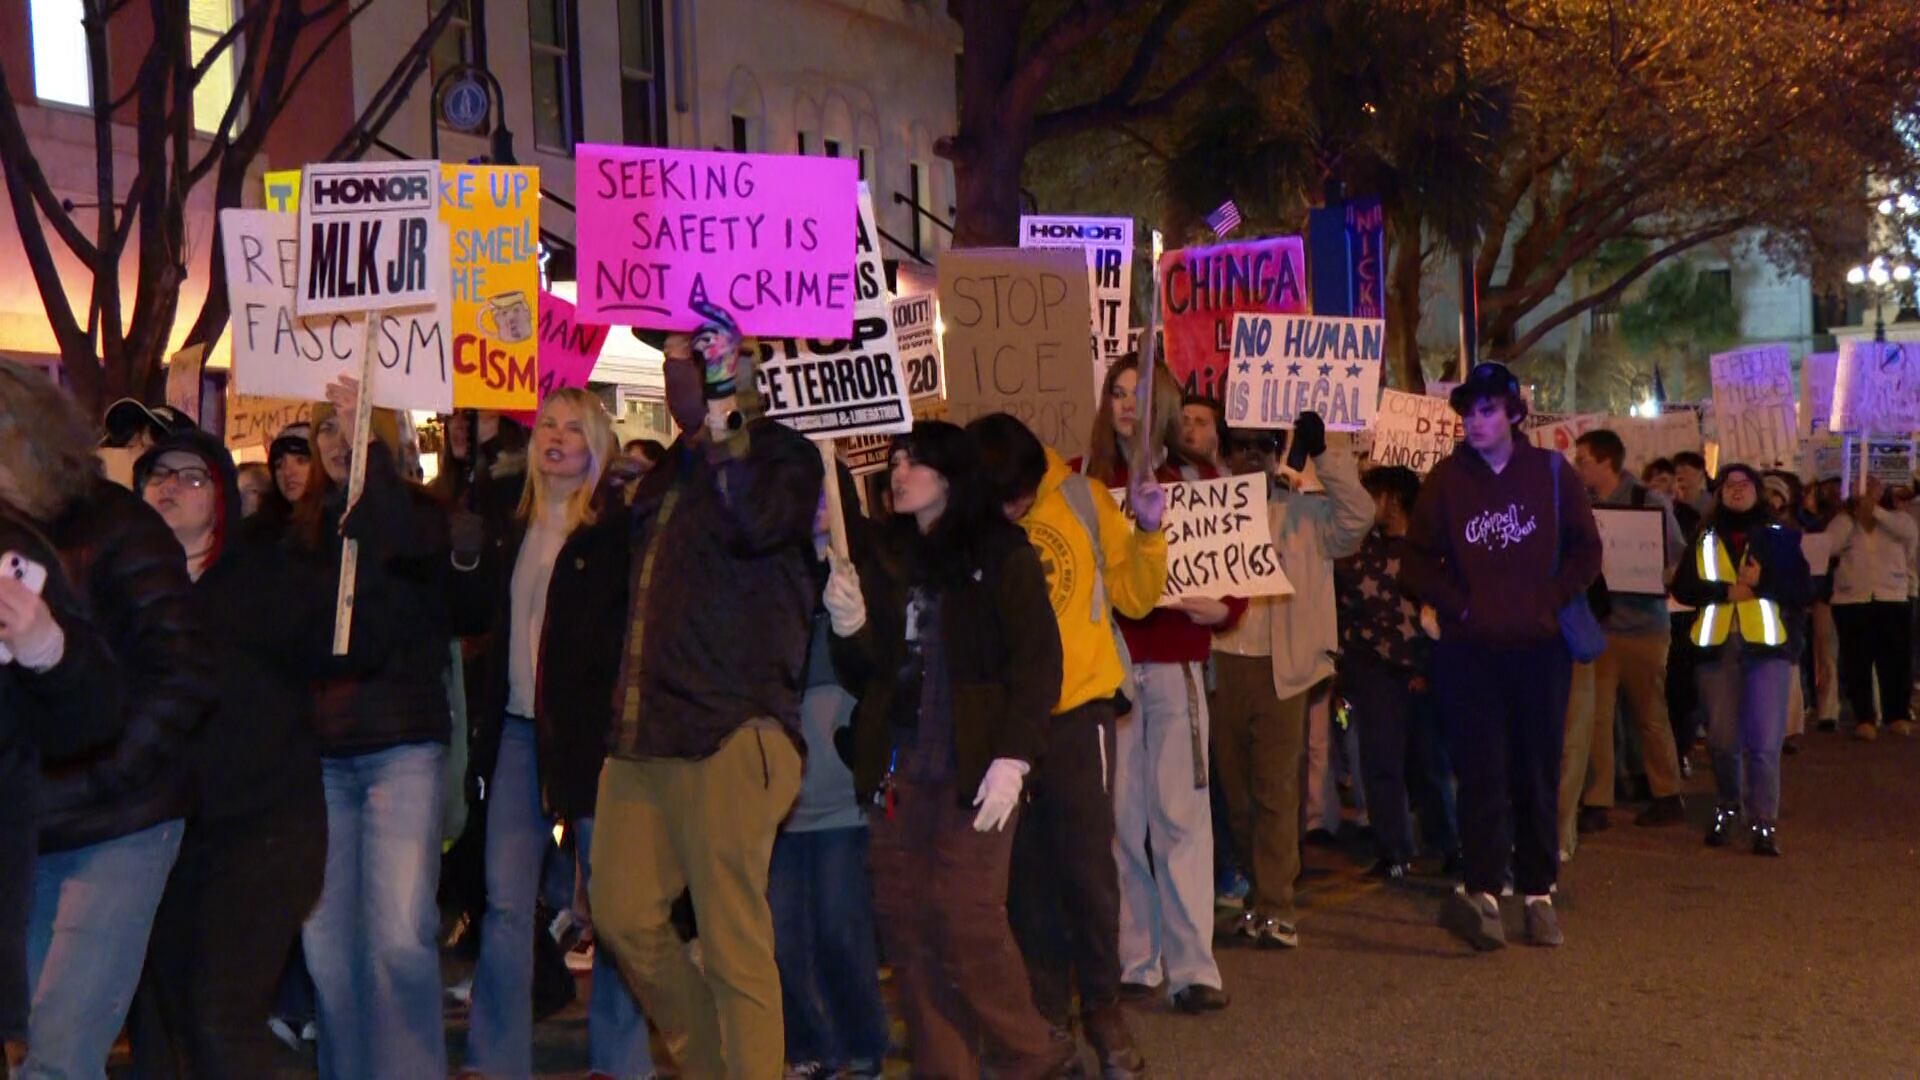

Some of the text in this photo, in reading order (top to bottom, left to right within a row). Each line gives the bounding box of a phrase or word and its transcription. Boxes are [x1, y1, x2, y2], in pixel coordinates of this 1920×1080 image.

[313, 176, 428, 206] HONOR
[490, 173, 529, 209] UP
[597, 159, 754, 200] SEEKING
[455, 216, 537, 265] SMELL
[632, 212, 818, 253] SAFETY IS
[1030, 224, 1122, 240] HONOR
[308, 217, 428, 301] MLK JR
[596, 259, 849, 311] NOT A CRIME
[954, 274, 1067, 330] STOP
[246, 303, 447, 383] FASCSM
[1233, 317, 1382, 360] NO HUMAN
[787, 352, 899, 408] TERROR
[907, 354, 938, 395] 20
[972, 344, 1066, 396] ICE
[1226, 380, 1252, 420] IS
[1261, 377, 1366, 427] ILLEGAL
[1416, 417, 1464, 438] DIE
[1163, 482, 1250, 510] RANS
